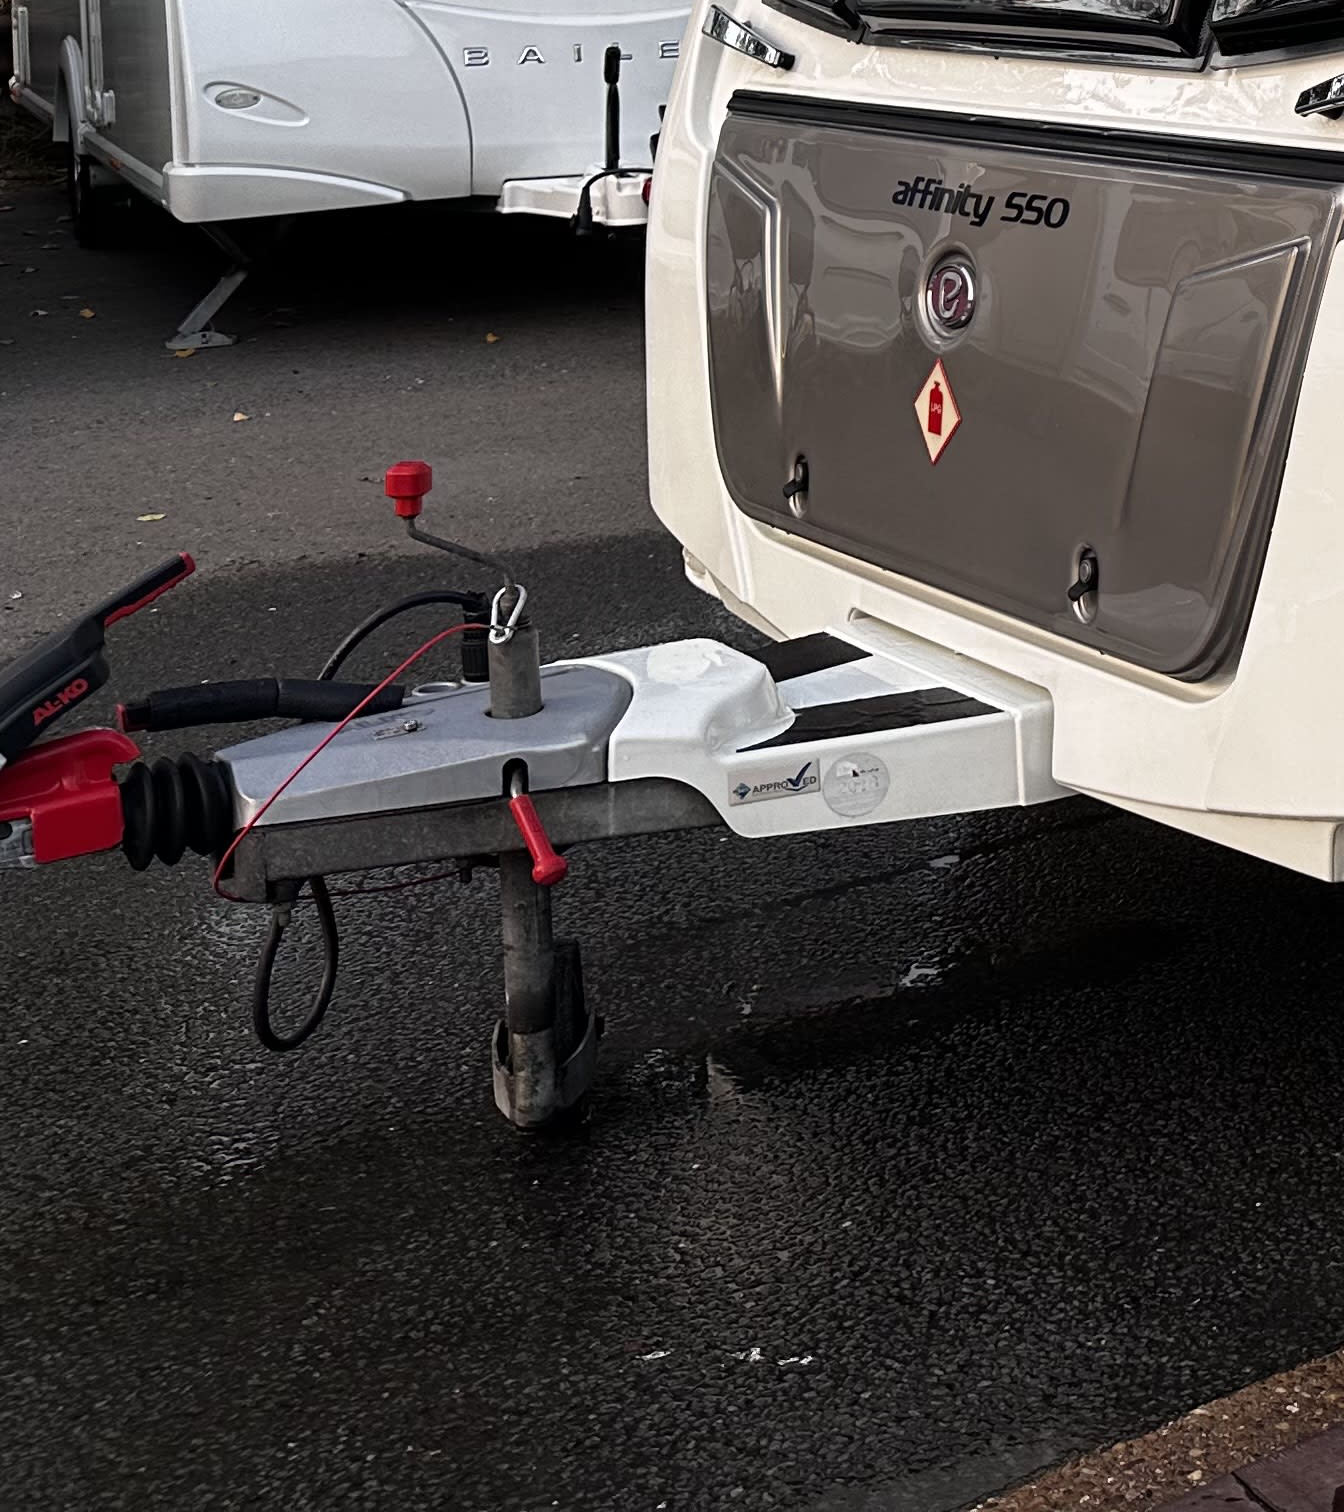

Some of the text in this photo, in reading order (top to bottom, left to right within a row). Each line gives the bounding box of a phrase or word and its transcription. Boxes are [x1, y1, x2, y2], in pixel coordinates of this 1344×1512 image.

[892, 175, 1071, 229] affinity 550
[32, 678, 89, 727] AL-KO
